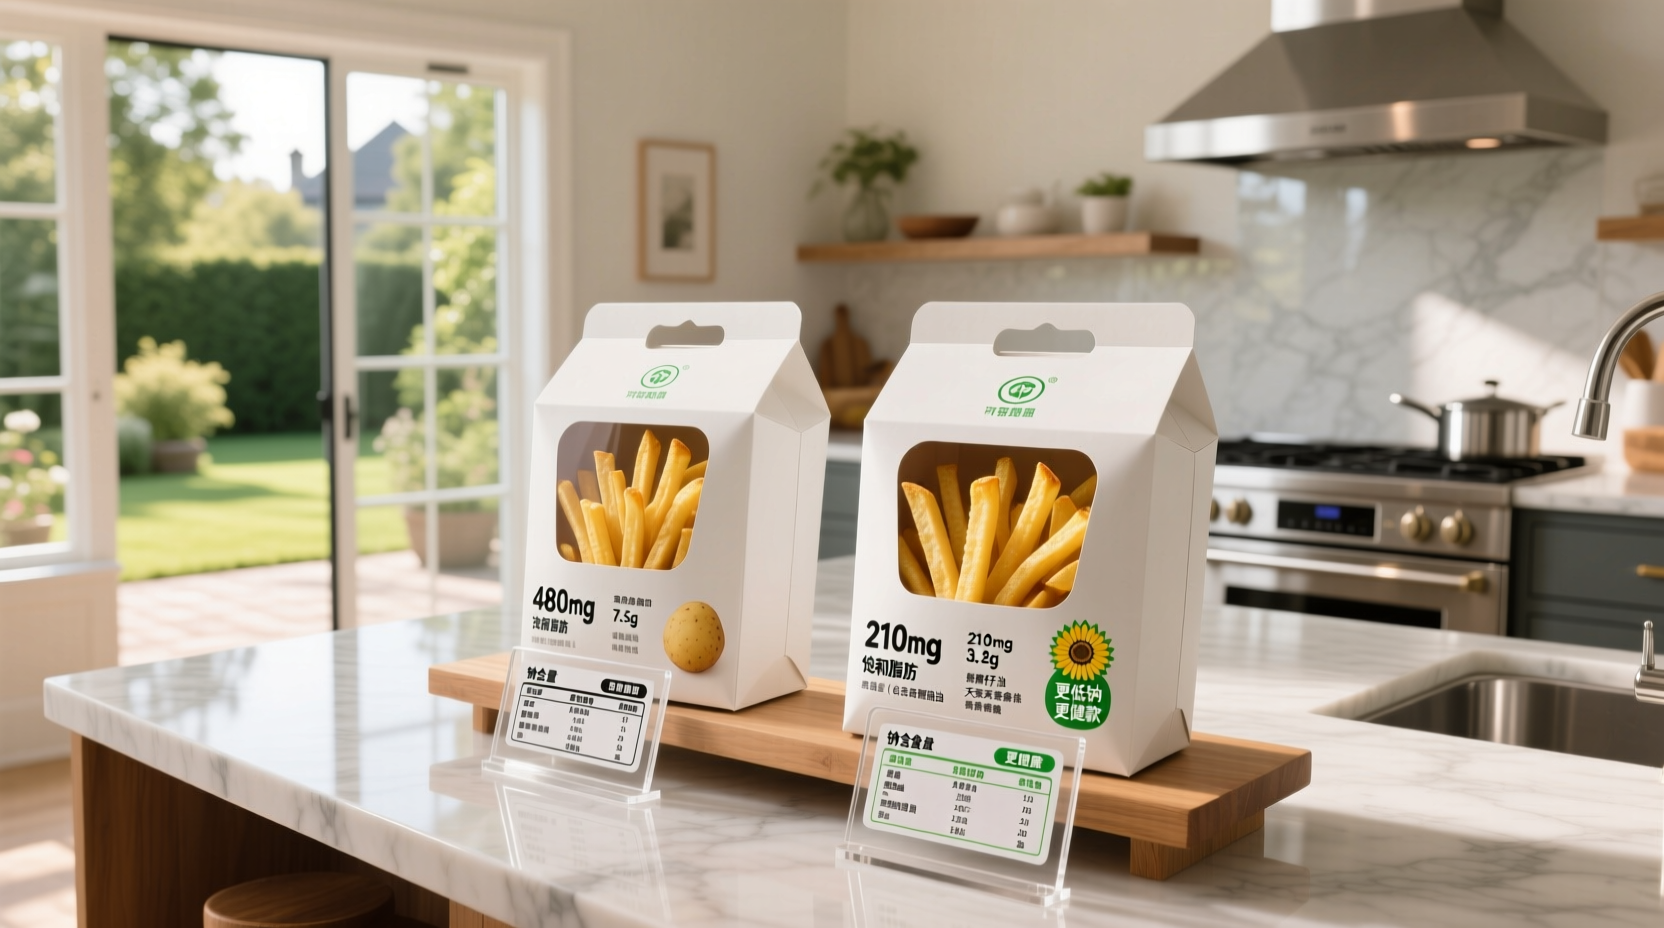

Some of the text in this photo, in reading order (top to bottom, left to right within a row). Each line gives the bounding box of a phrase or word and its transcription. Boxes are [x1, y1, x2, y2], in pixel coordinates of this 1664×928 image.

[532, 586, 595, 625] 480mg
[612, 608, 639, 629] 7.5g
[865, 620, 942, 665] 210mg
[967, 632, 1013, 653] 210mg
[966, 648, 999, 670] 3.2g
